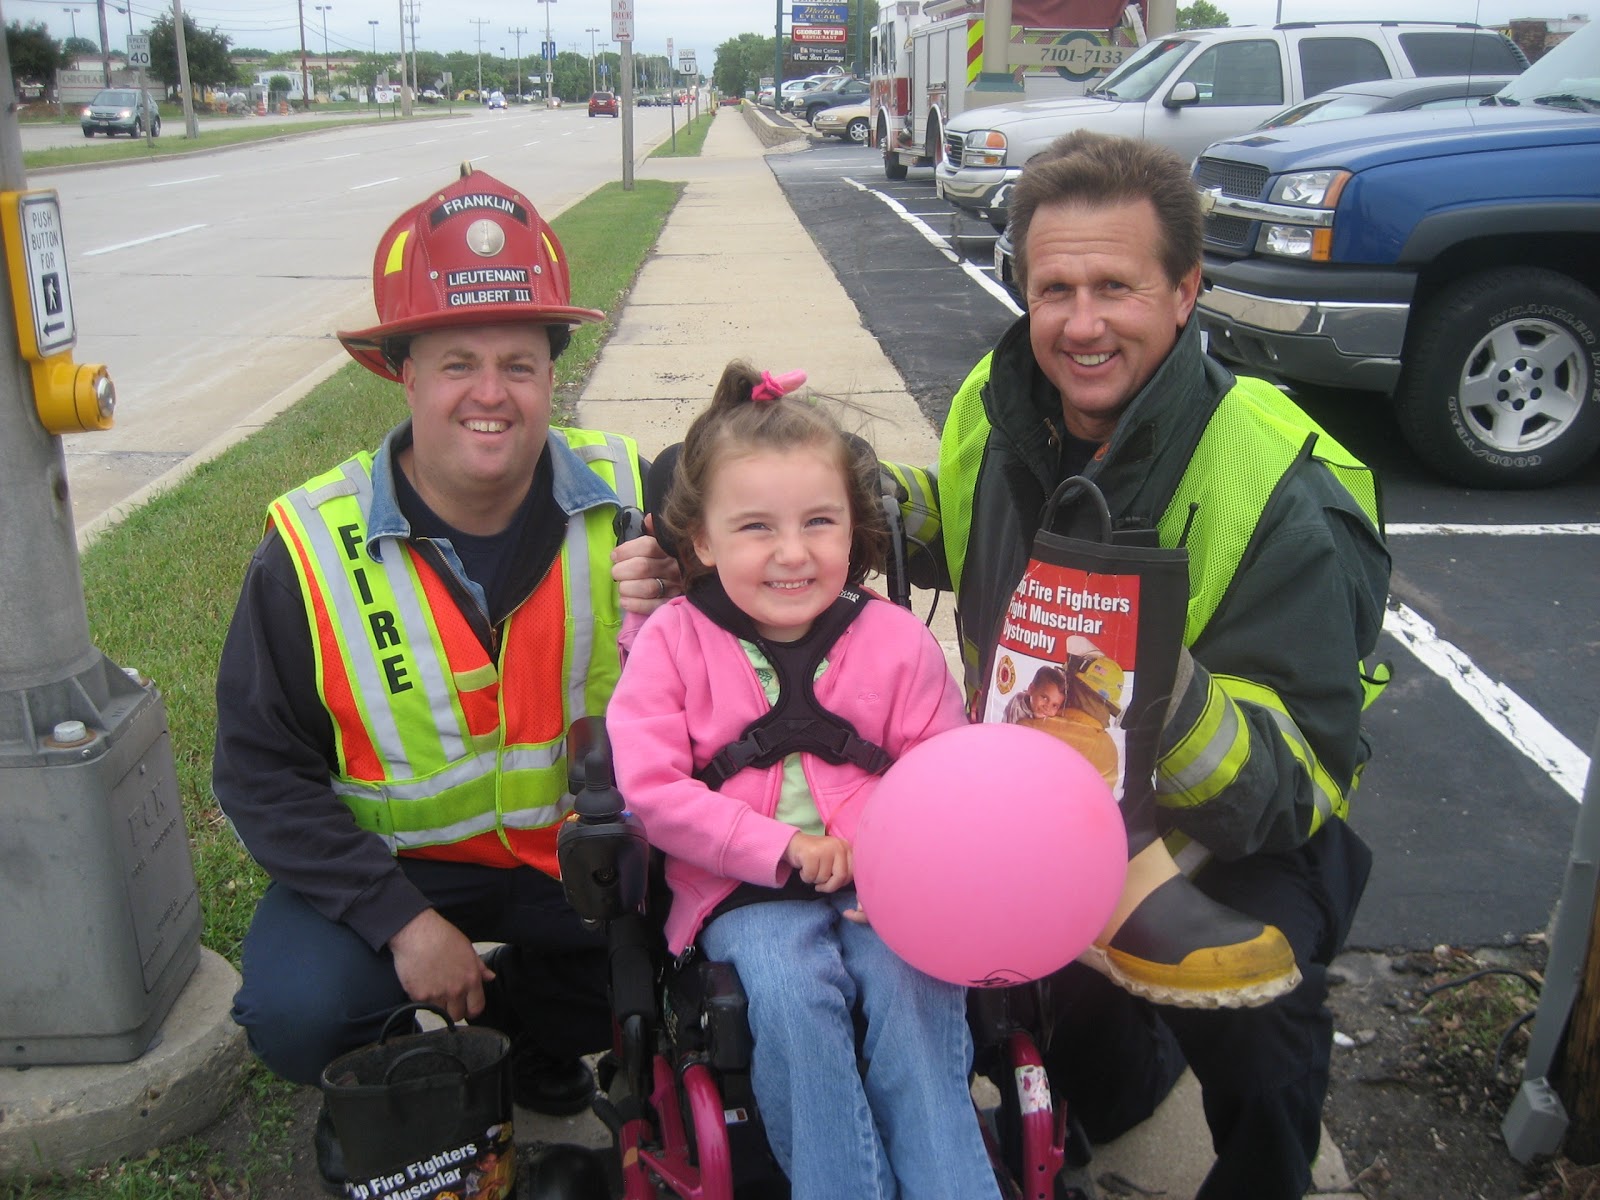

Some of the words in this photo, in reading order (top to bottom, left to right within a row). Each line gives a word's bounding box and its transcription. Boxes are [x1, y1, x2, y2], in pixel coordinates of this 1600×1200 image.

[618, 1, 627, 10] NO
[612, 11, 633, 20] PARKING
[130, 52, 149, 63] 40
[1040, 47, 1123, 64] 7101-7133
[684, 64, 692, 72] U
[443, 194, 515, 216] FRANKLIN
[32, 211, 53, 229] PUSH
[31, 231, 59, 251] BUTTON
[40, 252, 56, 270] FOR
[448, 269, 527, 286] LIEUTENANT
[450, 289, 511, 306] GUILBERT
[515, 289, 531, 302] III
[1448, 396, 1541, 467] GOODYEAR
[1028, 579, 1053, 602] Fire
[1056, 586, 1130, 613] Fighters
[337, 523, 414, 695] FIRE
[1029, 603, 1103, 635] Muscular
[1003, 618, 1056, 654] Dystrophy
[369, 1171, 406, 1196] Fire
[406, 1142, 478, 1180] Fighters
